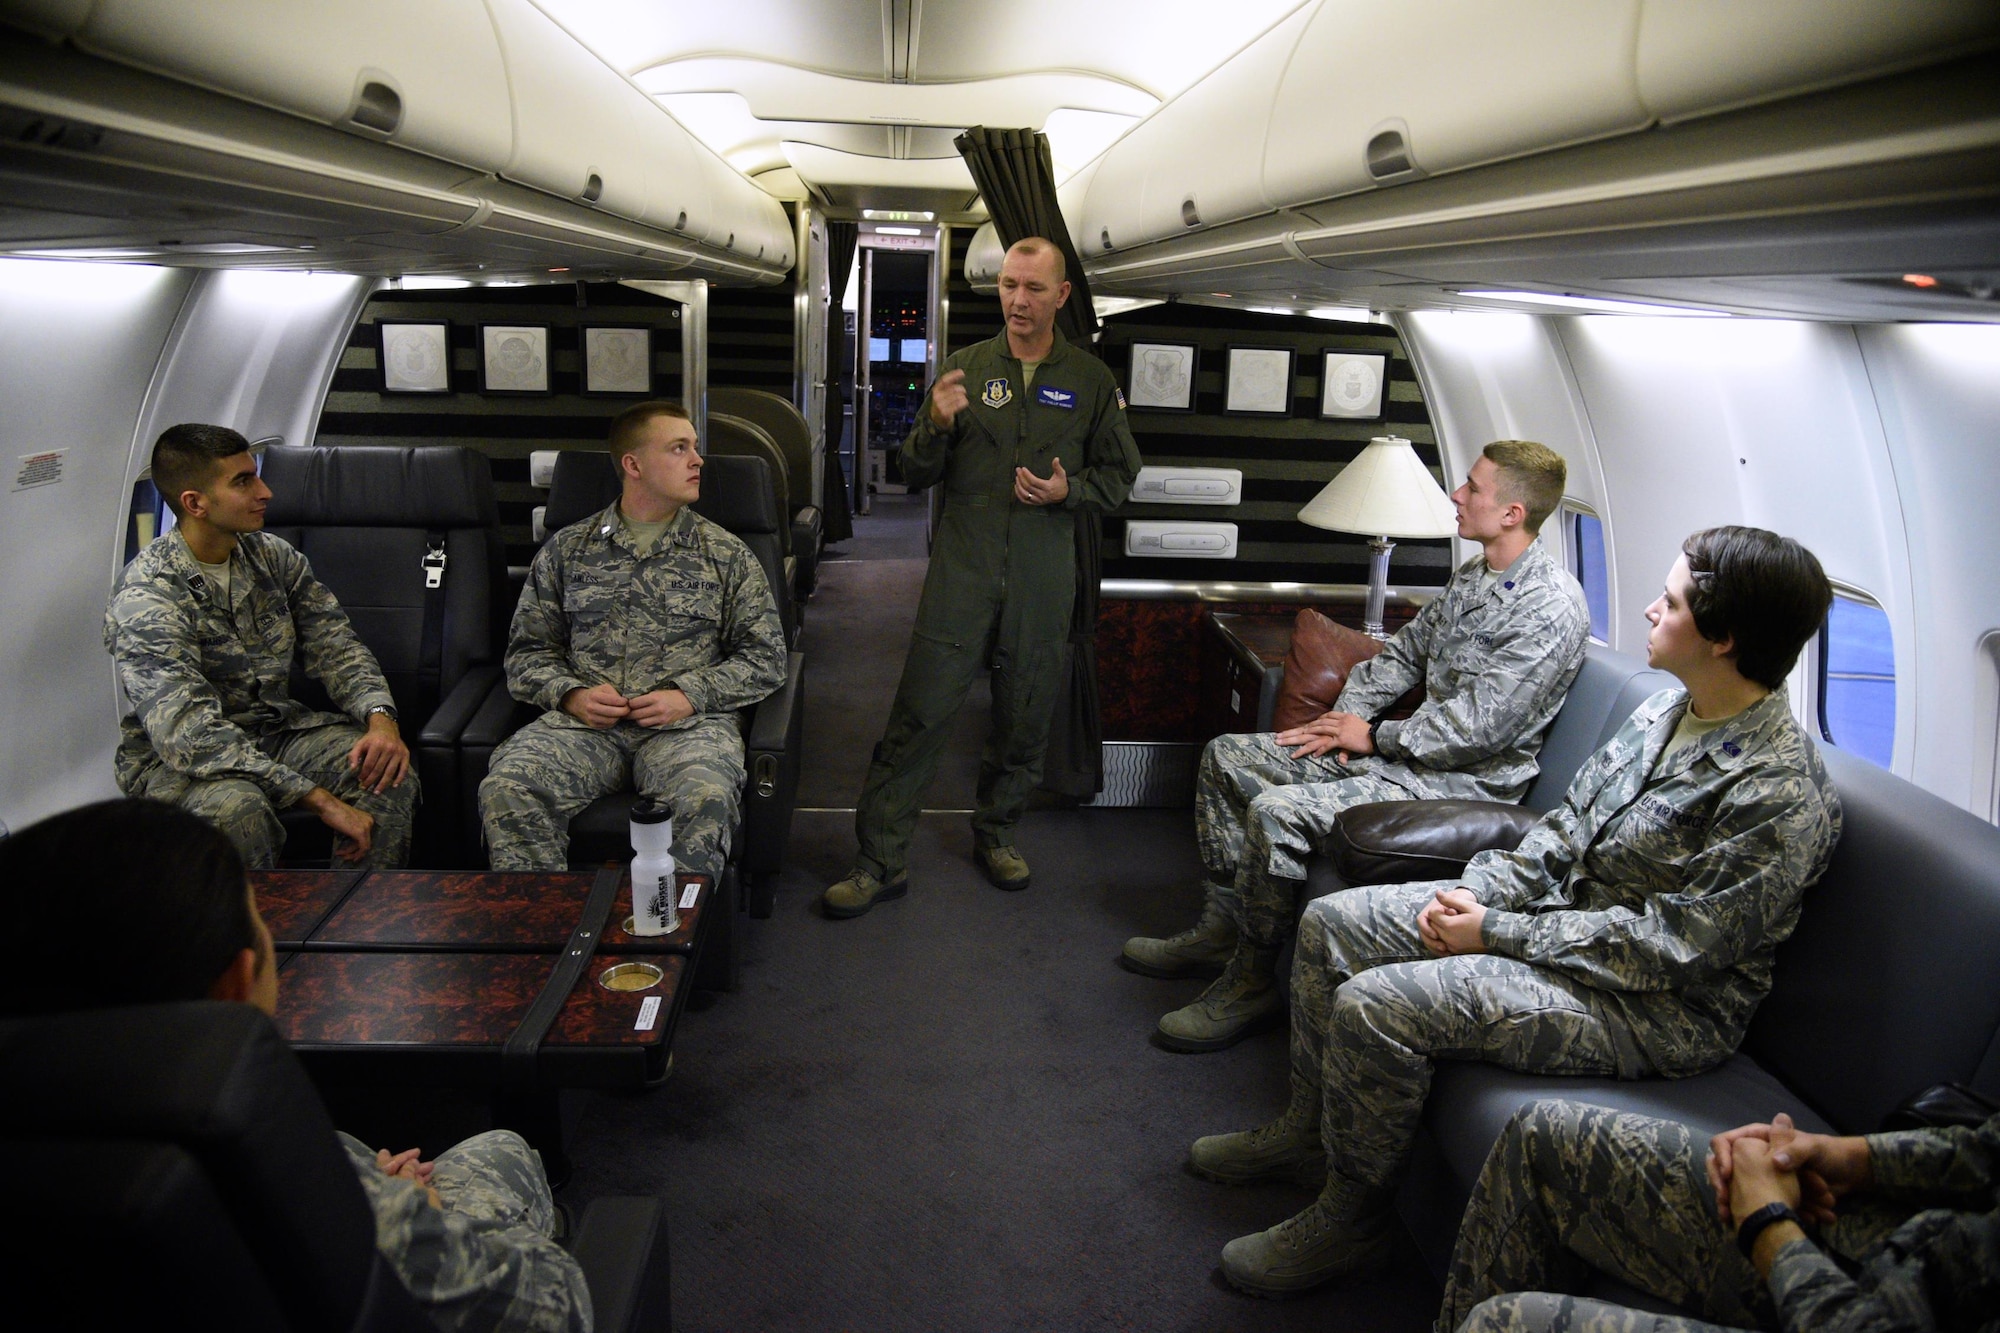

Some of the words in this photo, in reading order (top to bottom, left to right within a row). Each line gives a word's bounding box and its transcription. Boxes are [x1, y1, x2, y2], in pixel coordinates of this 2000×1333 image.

[687, 581, 700, 589] AIR
[701, 582, 721, 593] FORCE
[276, 605, 288, 618] AIR
[1654, 803, 1671, 818] AIR
[1670, 810, 1709, 831] FORCE
[658, 876, 667, 908] MUSCLE
[660, 909, 668, 928] MAX
